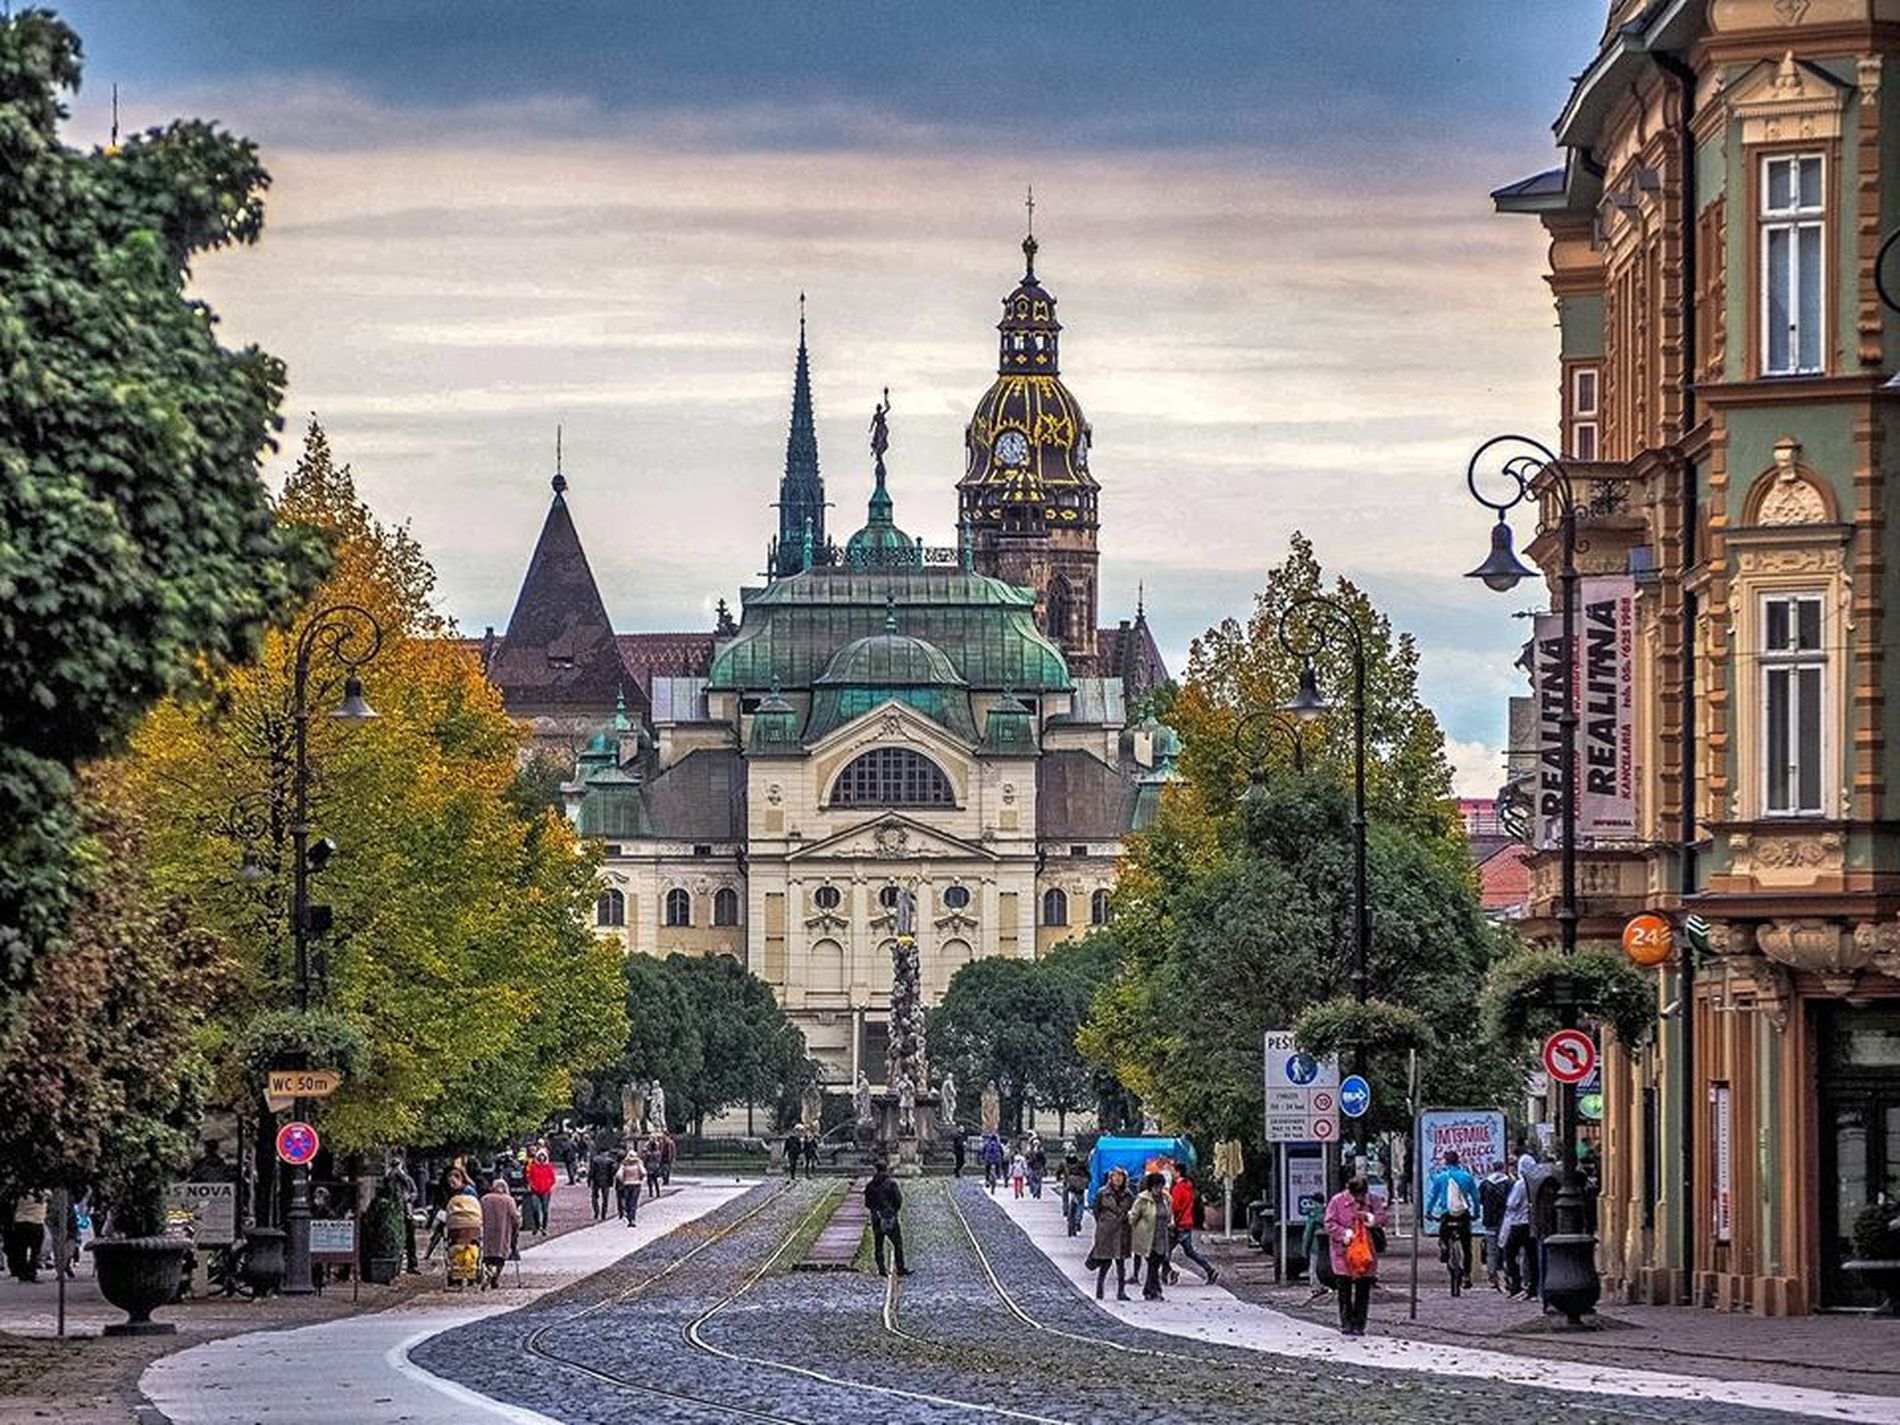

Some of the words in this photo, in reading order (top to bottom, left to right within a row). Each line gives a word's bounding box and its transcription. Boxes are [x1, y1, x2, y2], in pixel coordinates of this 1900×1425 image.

[1585, 598, 1617, 797] REALITNÁ
[1631, 926, 1659, 946] 24
[272, 1078, 292, 1091] WC
[297, 1076, 328, 1091] 50m
[186, 1185, 232, 1198] NOVA
